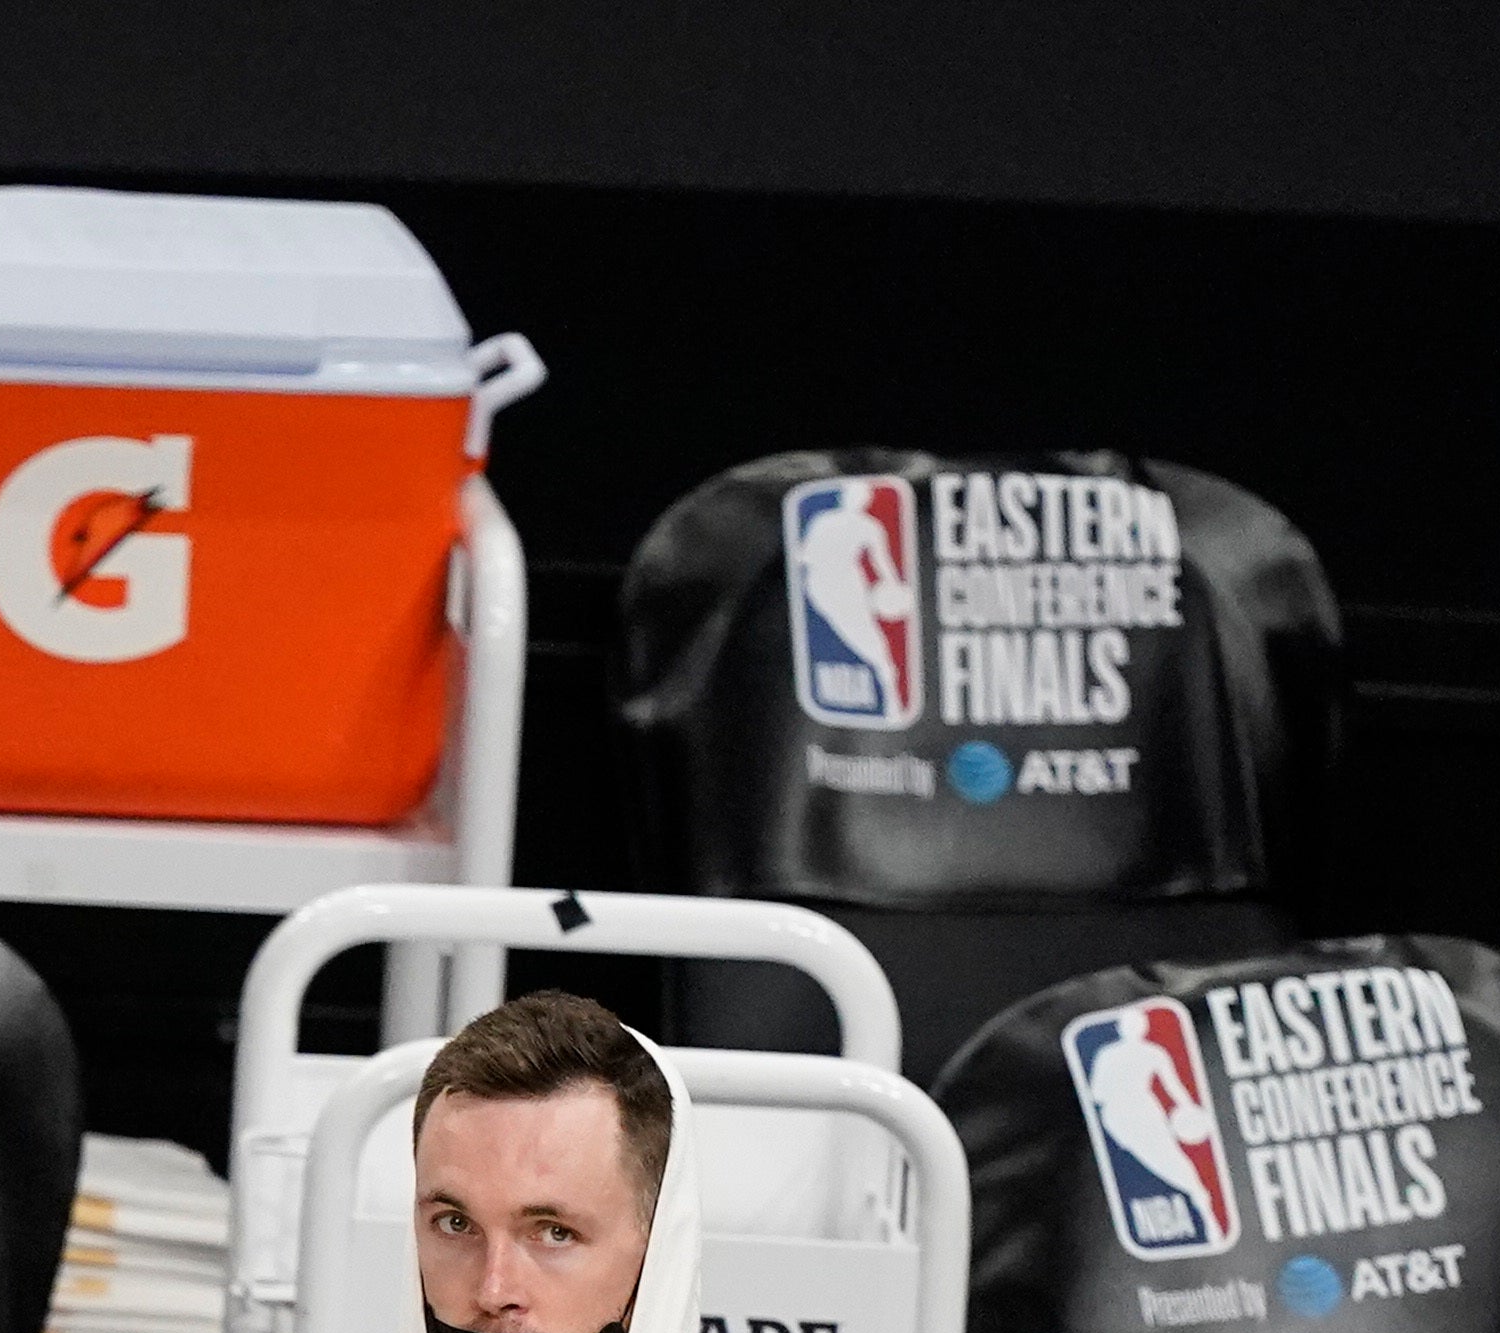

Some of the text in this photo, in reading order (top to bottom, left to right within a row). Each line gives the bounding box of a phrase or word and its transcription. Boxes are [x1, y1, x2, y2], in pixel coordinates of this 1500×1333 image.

[931, 470, 1181, 559] EASTERN
[938, 561, 1184, 628] CONFERENCE
[939, 627, 1131, 725] FINALS
[1017, 747, 1140, 796] AT&T
[1206, 966, 1468, 1080] EASTERN
[1231, 1047, 1484, 1147] CONFERENCE
[1246, 1122, 1447, 1243] FINALS
[1351, 1243, 1466, 1303] AT&T
